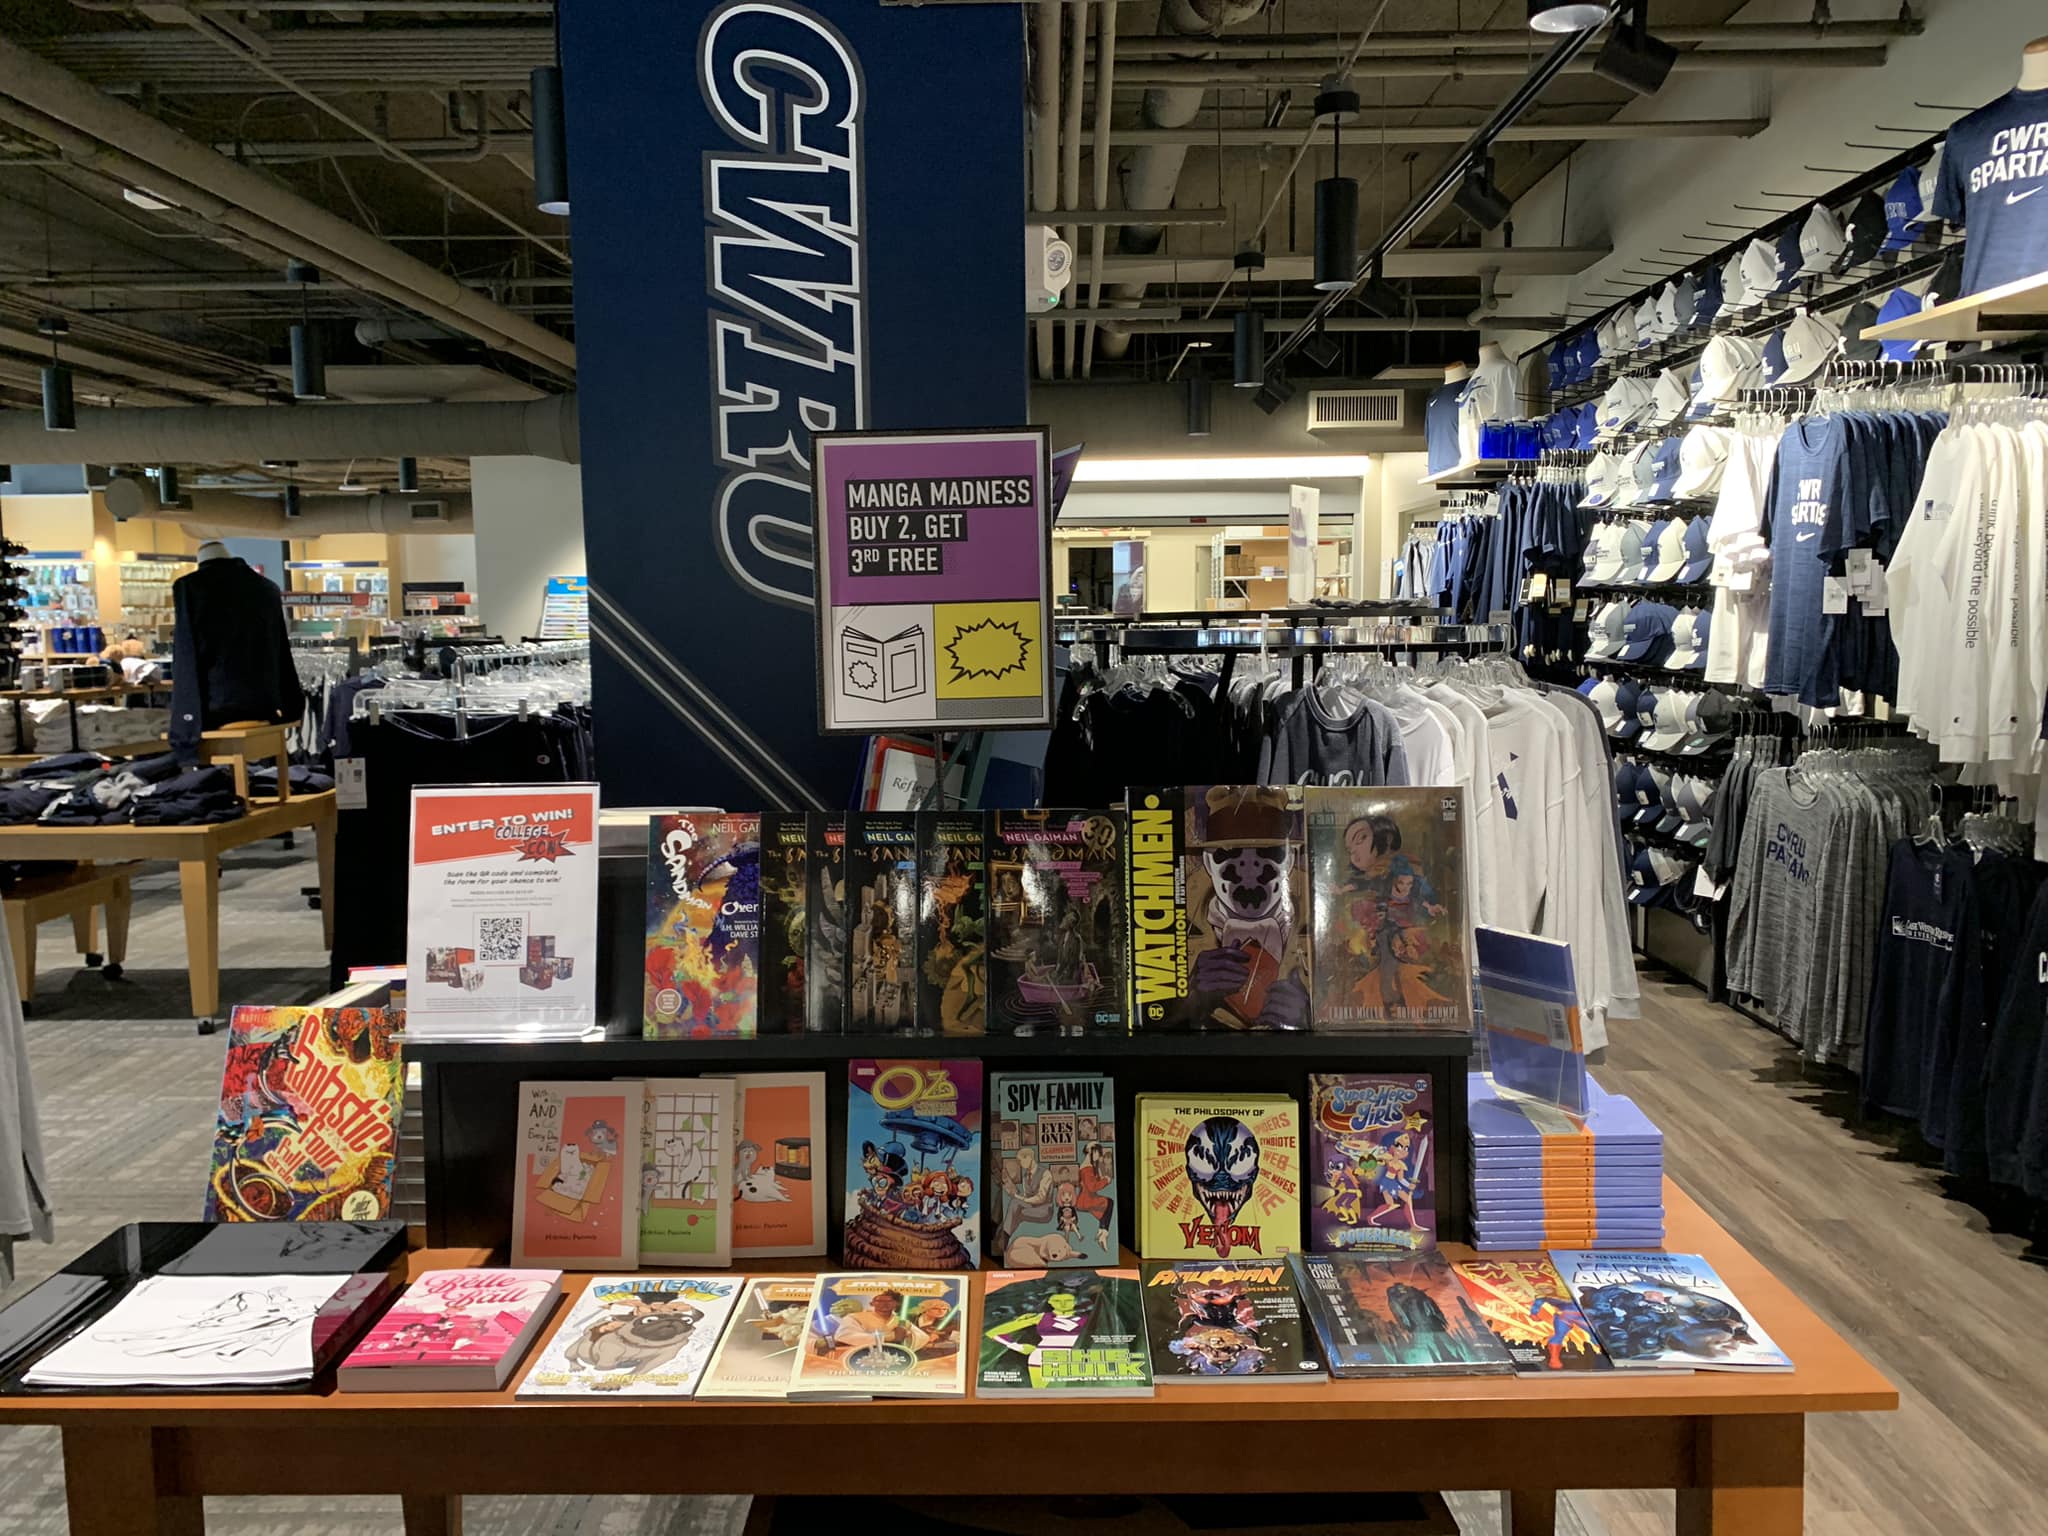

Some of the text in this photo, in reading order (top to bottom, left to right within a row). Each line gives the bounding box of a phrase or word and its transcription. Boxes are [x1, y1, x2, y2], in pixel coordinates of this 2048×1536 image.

[848, 479, 1031, 508] MANGA MADNESS
[850, 514, 963, 542] BUY 2, GET
[852, 547, 939, 573] 3RD FREE
[1970, 575, 1983, 596] the
[1965, 599, 1980, 649] possible
[431, 808, 574, 836] ENTER TO WIN!
[712, 823, 736, 833] NEIL
[495, 825, 549, 840] COLLEGE
[781, 834, 806, 842] NEIL
[867, 833, 893, 841] NEIL
[938, 833, 963, 842] NEIL
[1006, 833, 1078, 842] NEIL GAIMAN
[527, 841, 558, 855] CON
[1011, 843, 1116, 864] SADMAN
[1132, 809, 1177, 1004] WATCHMEN
[1175, 909, 1188, 998] COMPANION
[1148, 1005, 1164, 1019] DC
[1007, 1082, 1105, 1112] SPY FAMILY
[529, 1103, 557, 1118] AND
[1174, 1107, 1265, 1117] THE PHILOSOPHY OF
[1041, 1122, 1073, 1133] EYES
[1041, 1133, 1073, 1144] ONLY
[1263, 1149, 1290, 1171] WEB
[1179, 1215, 1263, 1255] VENOM
[1311, 1270, 1335, 1279] ONE
[892, 1281, 937, 1289] WARS
[1042, 1362, 1146, 1377] HULK
